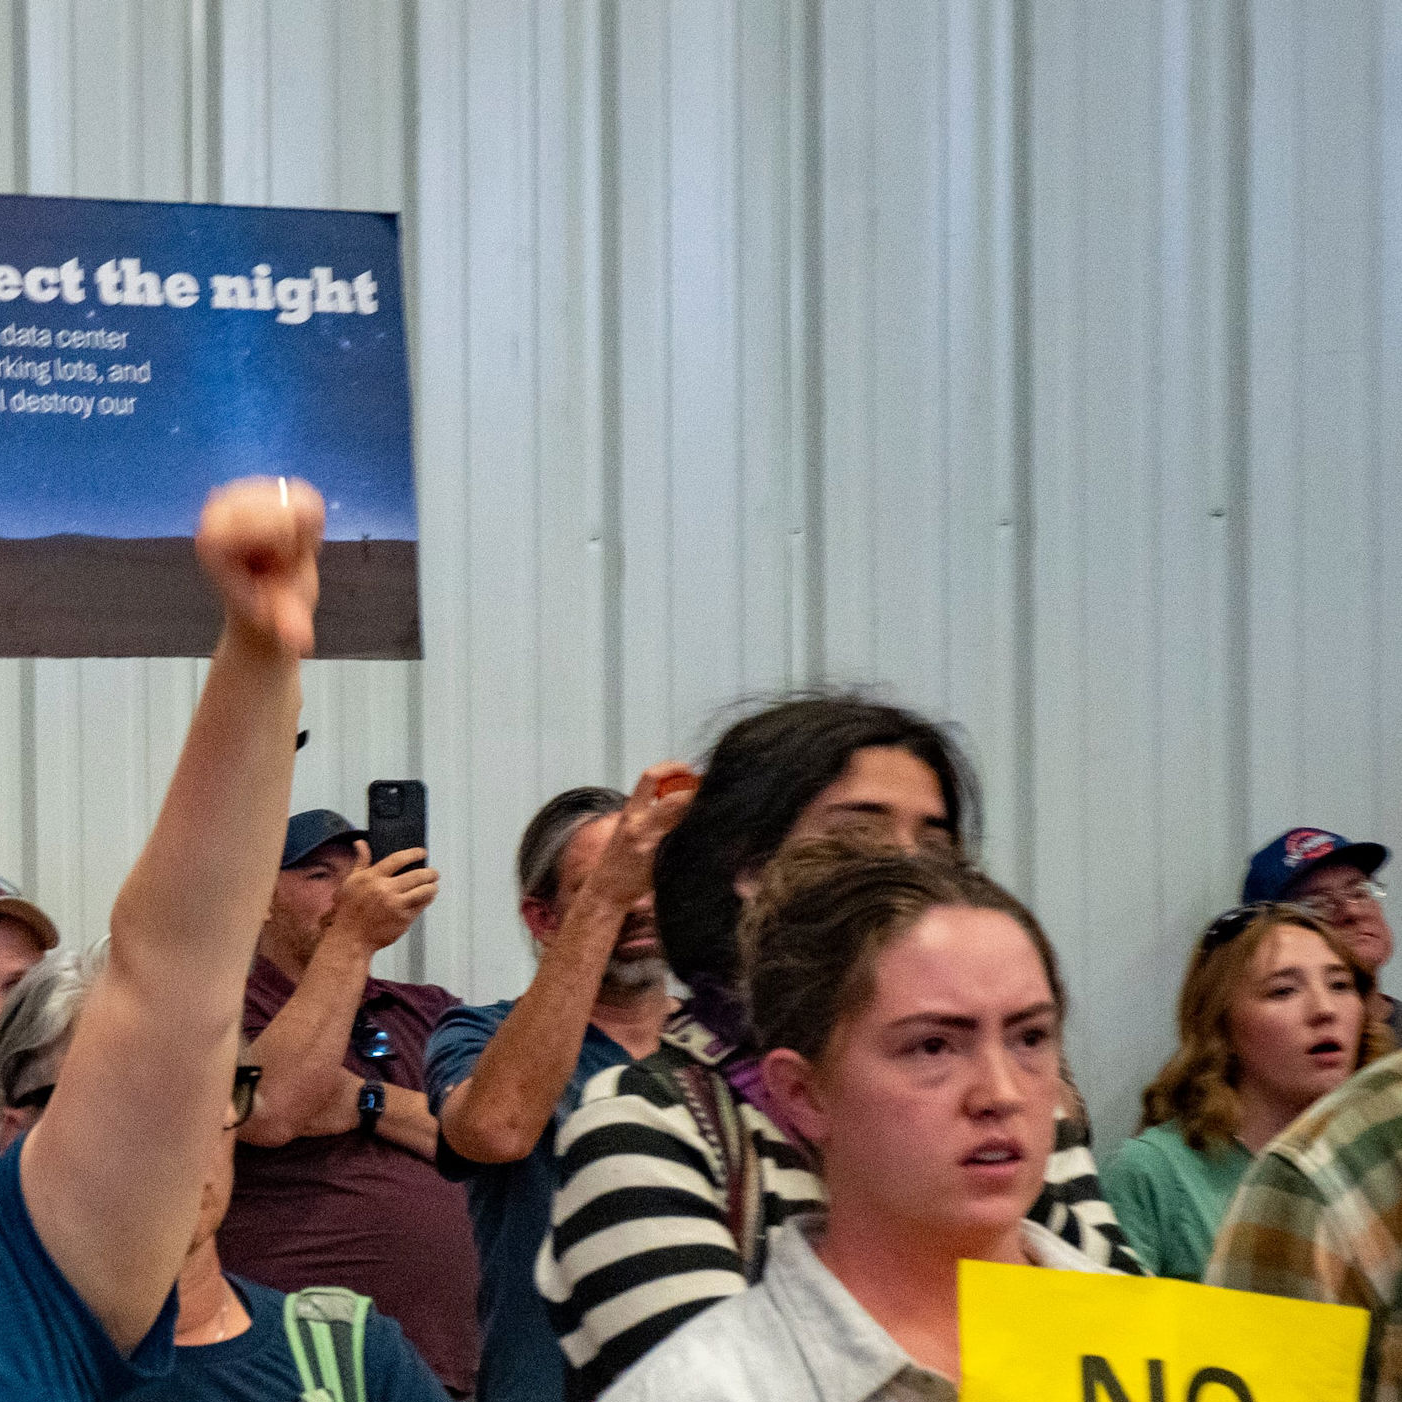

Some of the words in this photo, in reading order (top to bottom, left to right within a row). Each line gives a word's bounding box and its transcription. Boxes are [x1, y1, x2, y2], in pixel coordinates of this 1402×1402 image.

[94, 257, 200, 308] the
[211, 263, 379, 325] night
[0, 322, 52, 349] data
[56, 327, 129, 350] center
[54, 358, 103, 385] lots,
[107, 360, 152, 383] and
[10, 390, 95, 420] destroy
[98, 395, 138, 416] our
